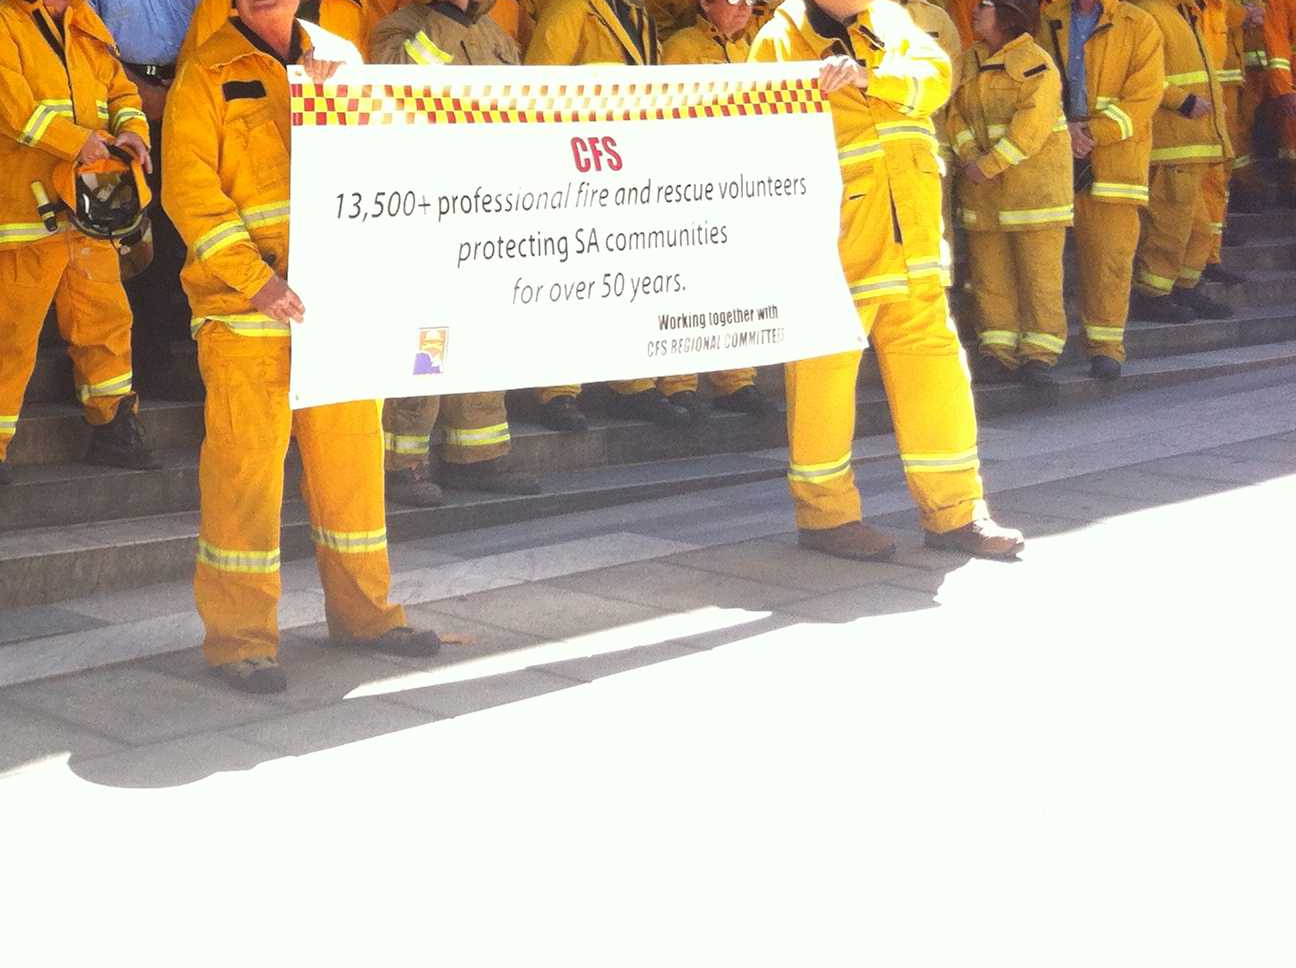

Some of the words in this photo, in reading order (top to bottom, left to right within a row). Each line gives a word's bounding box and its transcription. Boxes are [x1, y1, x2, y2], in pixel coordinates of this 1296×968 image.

[570, 135, 624, 173] CFS
[335, 190, 431, 222] 13,500+
[437, 182, 572, 222] professional
[575, 181, 610, 209] fire
[614, 178, 652, 207] and
[656, 181, 714, 204] rescue
[718, 173, 808, 200] volunteers
[457, 230, 569, 268] protecting
[575, 227, 601, 254] SA
[605, 220, 729, 252] communities
[512, 277, 545, 304] for
[549, 281, 596, 303] over
[601, 272, 625, 298] 50
[629, 272, 686, 303] years.
[658, 313, 706, 330] Working
[709, 308, 755, 326] together
[757, 304, 779, 320] with
[647, 340, 668, 357] CFS
[670, 335, 721, 354] REGIONAL
